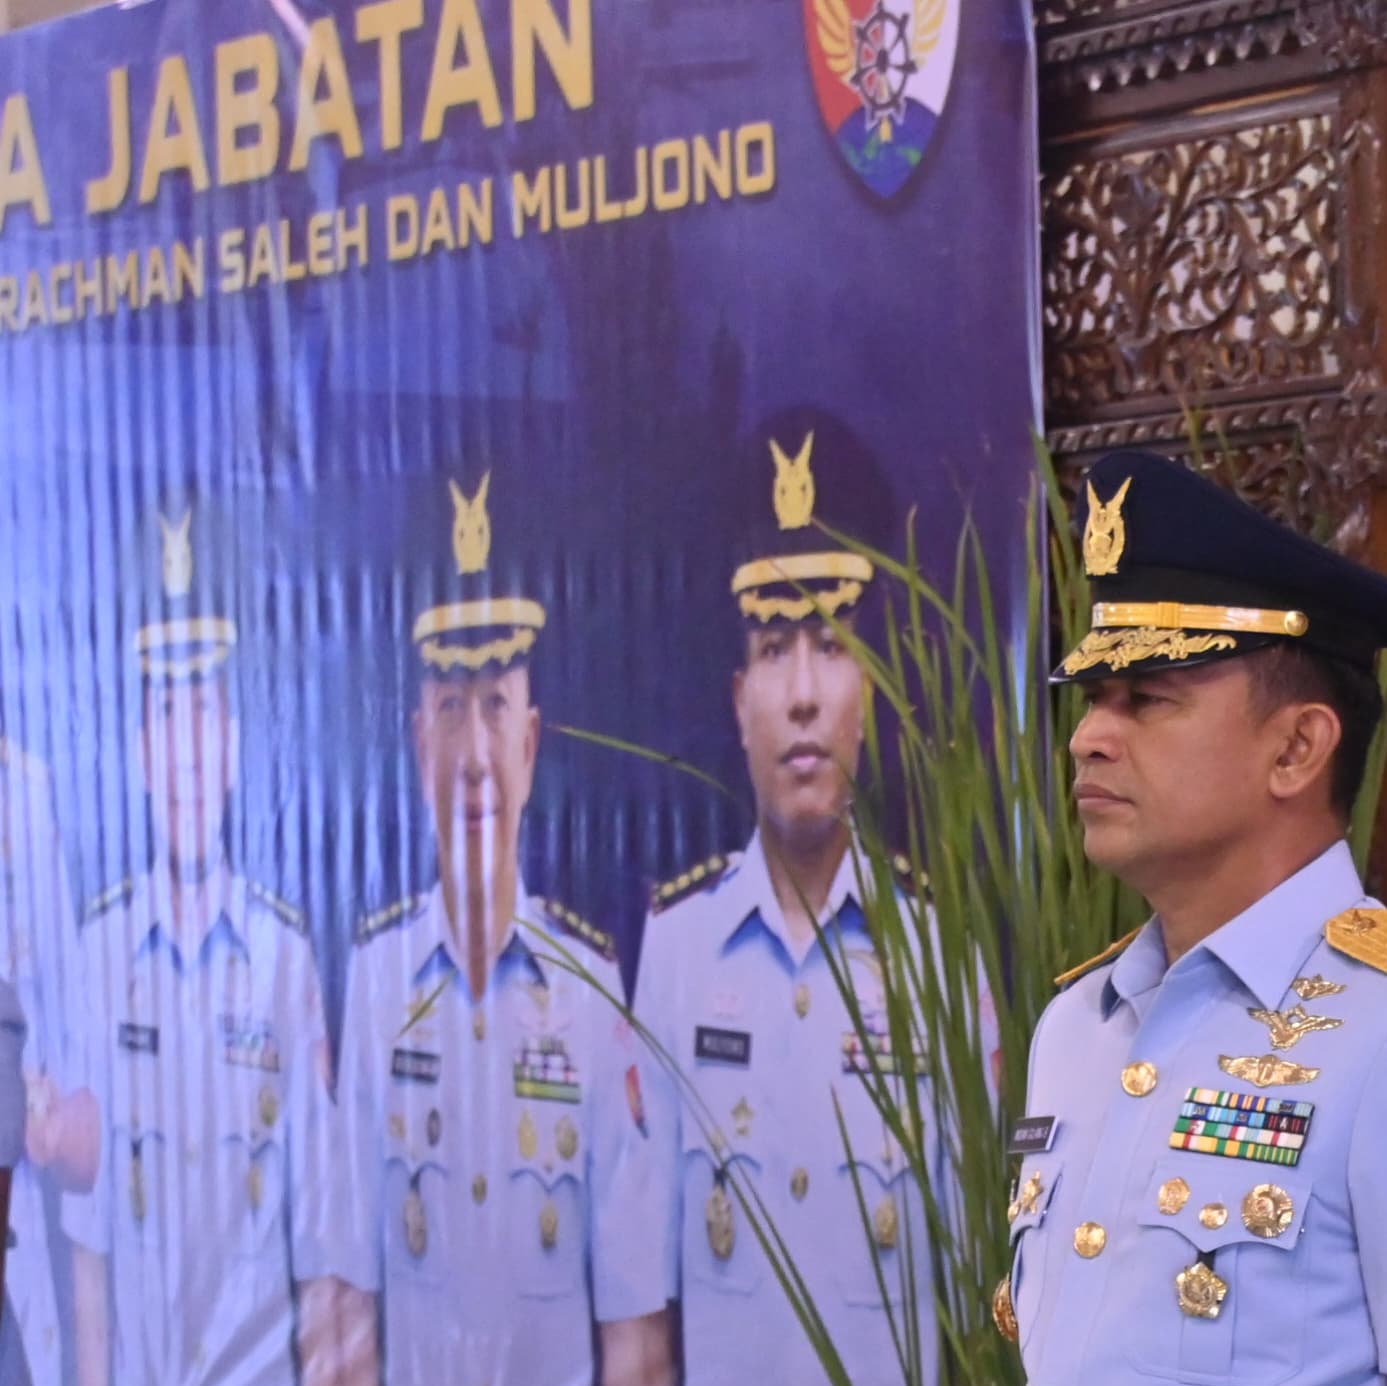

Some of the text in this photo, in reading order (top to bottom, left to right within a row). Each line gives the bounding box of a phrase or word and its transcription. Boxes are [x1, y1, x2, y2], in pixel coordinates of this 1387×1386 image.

[86, 0, 594, 214] JABATAN
[218, 203, 369, 294] SALEH
[386, 177, 493, 262] DAN
[511, 120, 775, 240] MULJONO
